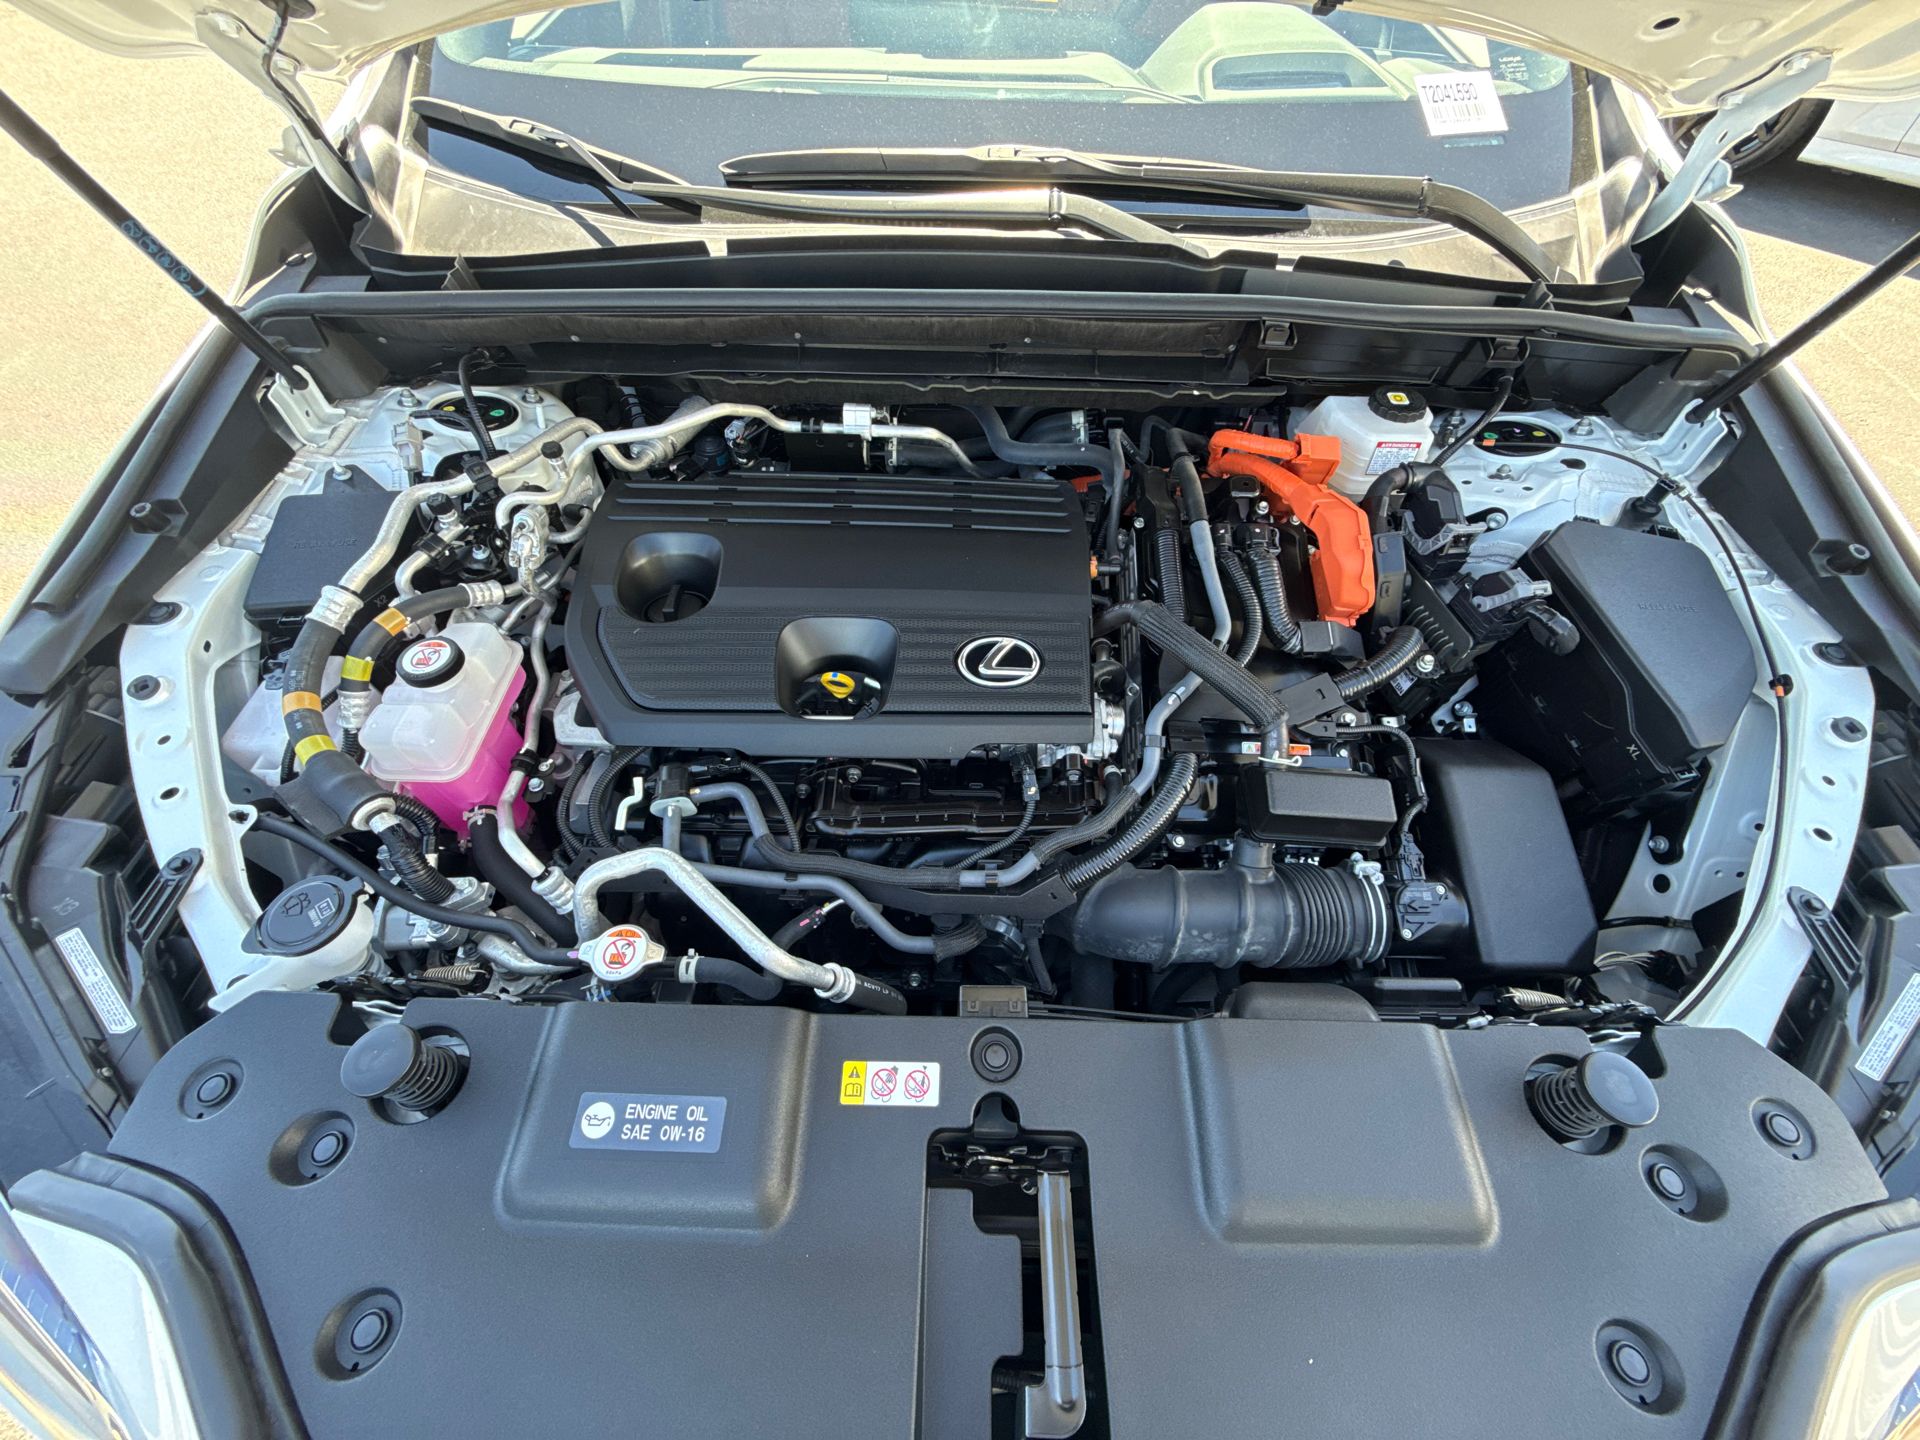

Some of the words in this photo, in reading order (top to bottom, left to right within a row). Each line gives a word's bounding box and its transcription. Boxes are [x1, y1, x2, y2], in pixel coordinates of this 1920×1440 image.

[1421, 82, 1478, 104] T2041590
[625, 1103, 678, 1120] ENGINE
[686, 1106, 709, 1122] OIL
[621, 1124, 652, 1140] SAE
[660, 1125, 706, 1142] 0W-16
